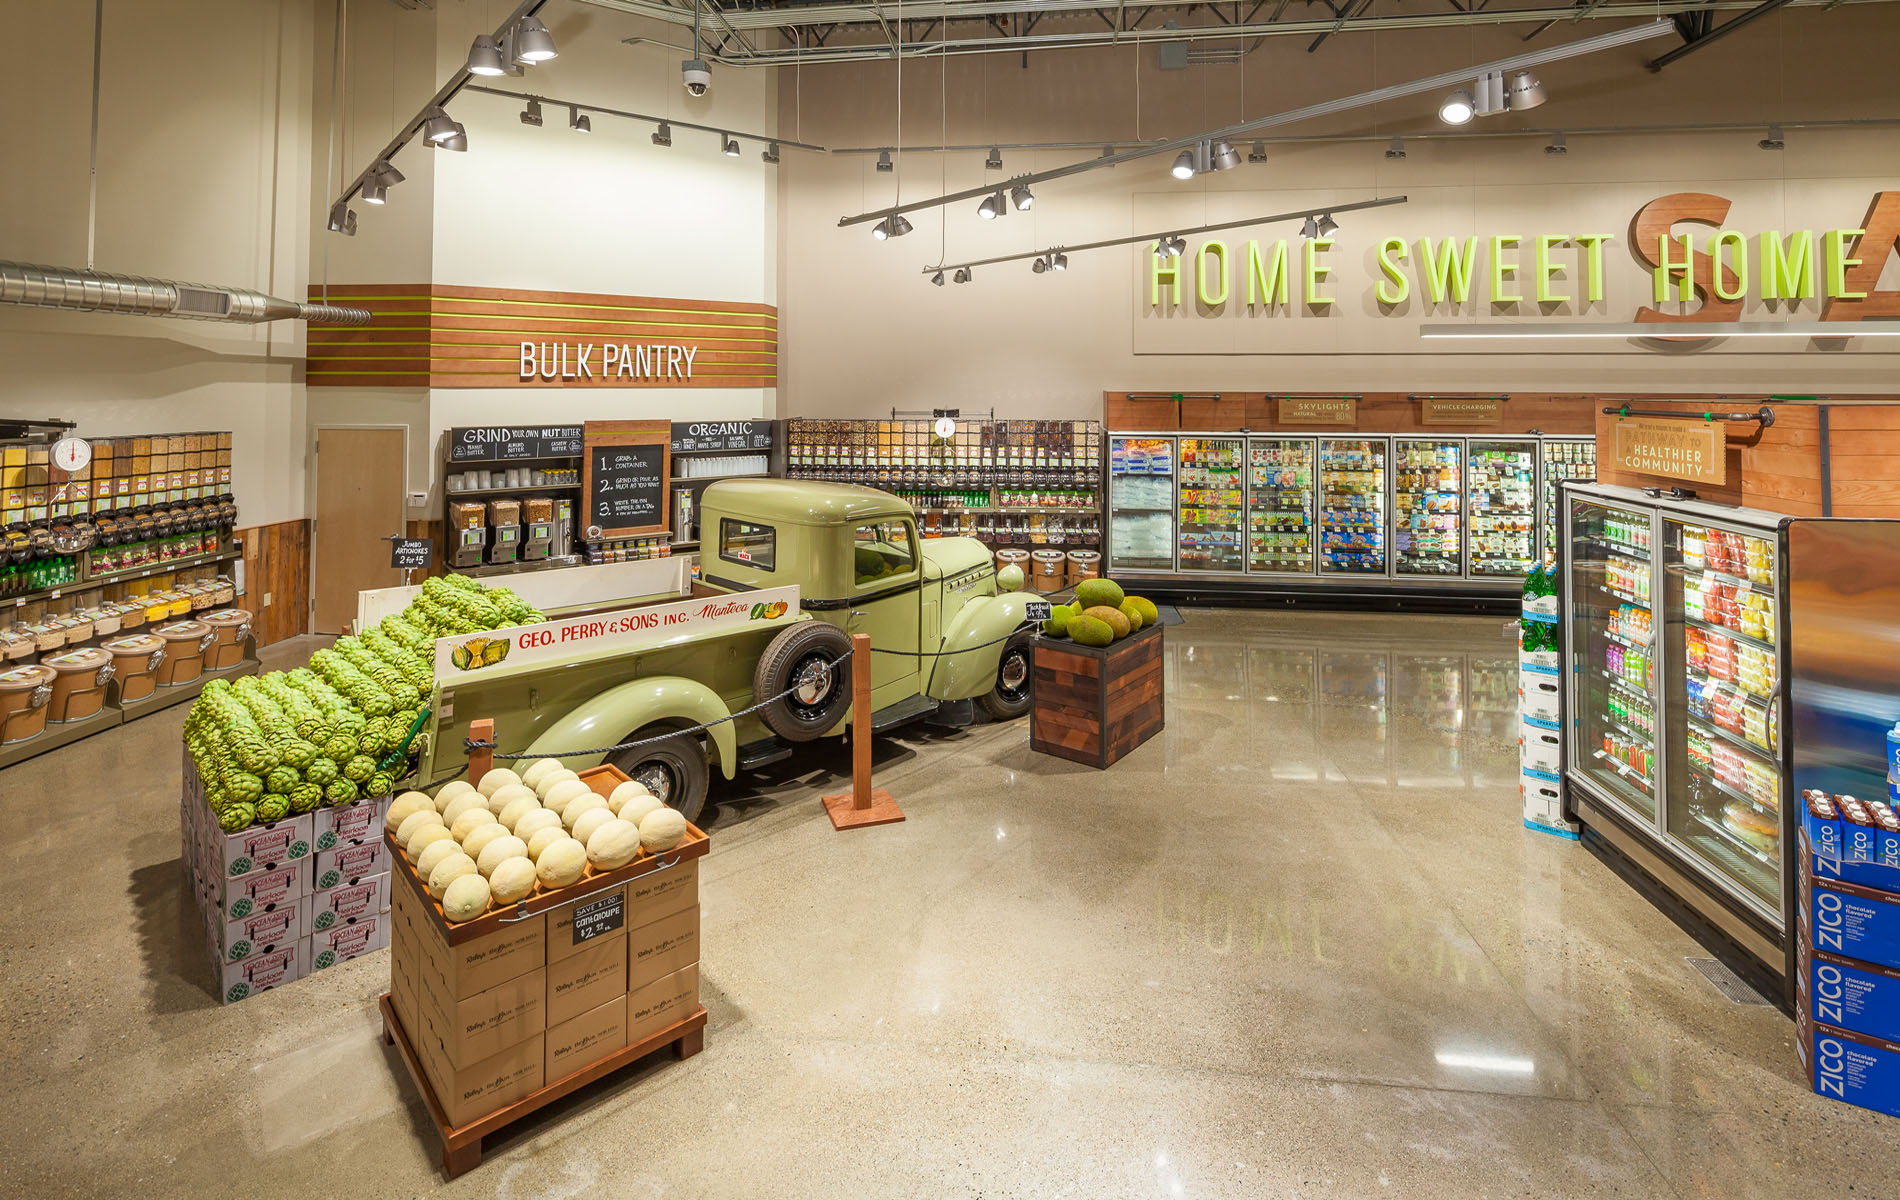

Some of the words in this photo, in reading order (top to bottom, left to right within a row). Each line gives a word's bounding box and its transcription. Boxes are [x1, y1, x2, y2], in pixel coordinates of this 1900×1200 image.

[1152, 239, 1336, 305] HOME
[1375, 234, 1614, 303] SWEET
[1654, 230, 1867, 302] HOME
[520, 342, 593, 377] BULK
[603, 344, 697, 378] PANTRY
[463, 428, 511, 443] GRIND
[511, 429, 525, 439] YOUR
[525, 430, 539, 438] OWN
[541, 428, 561, 438] NUT
[561, 428, 581, 437] BUTTER
[689, 422, 753, 436] ORGANIC
[728, 440, 746, 448] VINEGAR
[1690, 438, 1702, 447] TO
[1634, 445, 1701, 463] HEALTHIER
[601, 456, 612, 471] 1.
[615, 461, 648, 469] CONTAINER
[1625, 456, 1702, 476] COMMUNITY
[600, 479, 614, 493] 2.
[599, 501, 612, 516] 3.
[400, 555, 406, 564] 2
[416, 555, 424, 565] $5
[693, 601, 749, 620] Manteca
[519, 630, 556, 650] GEO.
[561, 622, 607, 643] PERRY
[609, 621, 618, 633] &
[620, 613, 658, 632] SONS
[664, 612, 689, 625] INC.
[338, 825, 368, 836] Heirloom
[1822, 826, 1835, 854] ZICO
[1855, 832, 1867, 860] ZICO
[254, 848, 287, 862] Heirloom
[1886, 839, 1898, 867] ZICO
[341, 863, 371, 875] Heirloom
[254, 890, 287, 903] Heirloom
[337, 903, 367, 915] Heirloom
[577, 905, 595, 916] SAVE
[1845, 904, 1876, 915] chocolate
[1845, 909, 1872, 919] flavored
[1818, 893, 1842, 950] ZICO
[254, 929, 286, 943] Heirloom
[337, 941, 367, 953] Heirloom
[252, 970, 284, 985] Heirloom
[1845, 977, 1876, 988] chocolate
[1845, 982, 1872, 992] flavored
[1818, 966, 1842, 1023] ZICO
[1847, 1051, 1877, 1063] chocolate
[1847, 1056, 1873, 1067] flavored
[1819, 1039, 1843, 1097] ZICO
